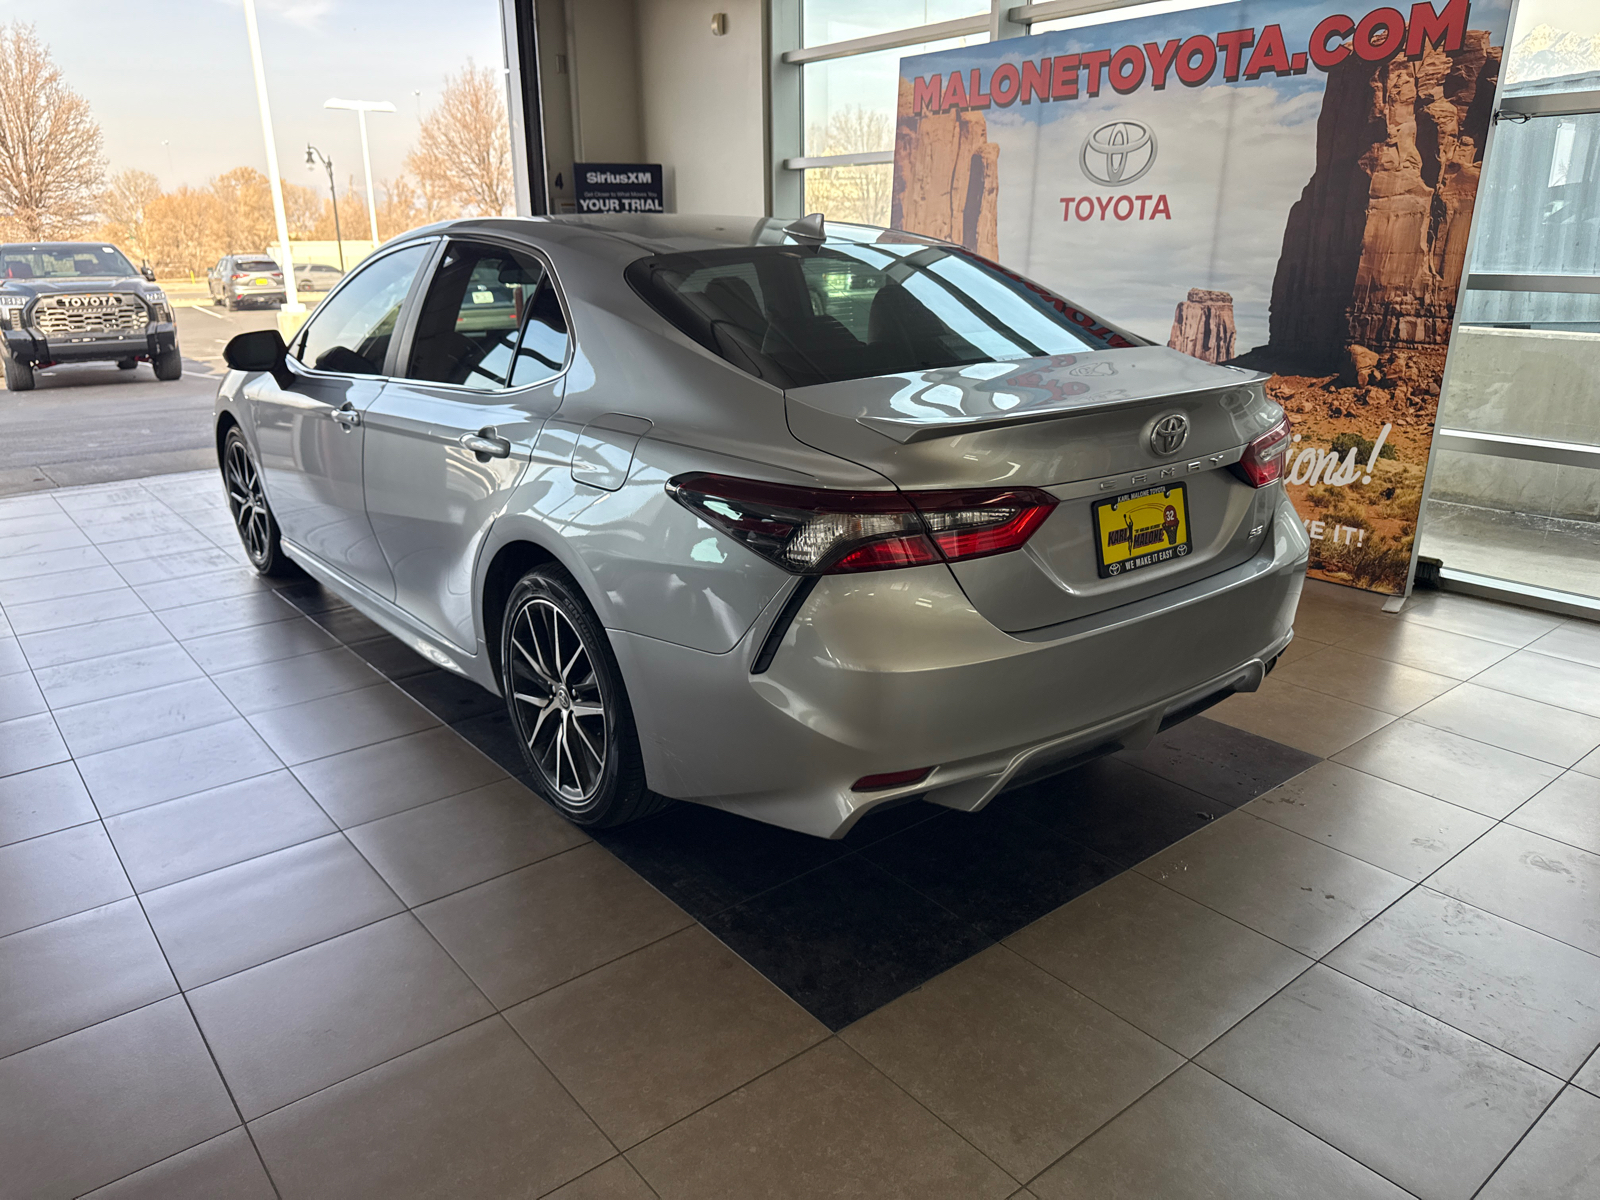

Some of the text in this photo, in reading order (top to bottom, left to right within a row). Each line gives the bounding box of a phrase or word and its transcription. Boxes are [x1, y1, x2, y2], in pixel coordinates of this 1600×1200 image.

[914, 0, 1471, 114] MALONETOYOTA.COM
[555, 172, 564, 190] 4
[586, 171, 652, 184] SiriusXM
[579, 198, 663, 211] YOUR TRIAL
[1059, 194, 1172, 222] TOYOTA
[62, 296, 118, 308] TOYOTA
[1100, 454, 1224, 490] CAMRY
[1117, 486, 1166, 503] KARL MALONE TOYOTA
[1166, 510, 1175, 521] 32
[1107, 528, 1129, 547] KARL
[1133, 527, 1165, 549] MALONE
[1333, 524, 1364, 547] IT!
[1125, 550, 1173, 570] WE MAKE IT EASY
